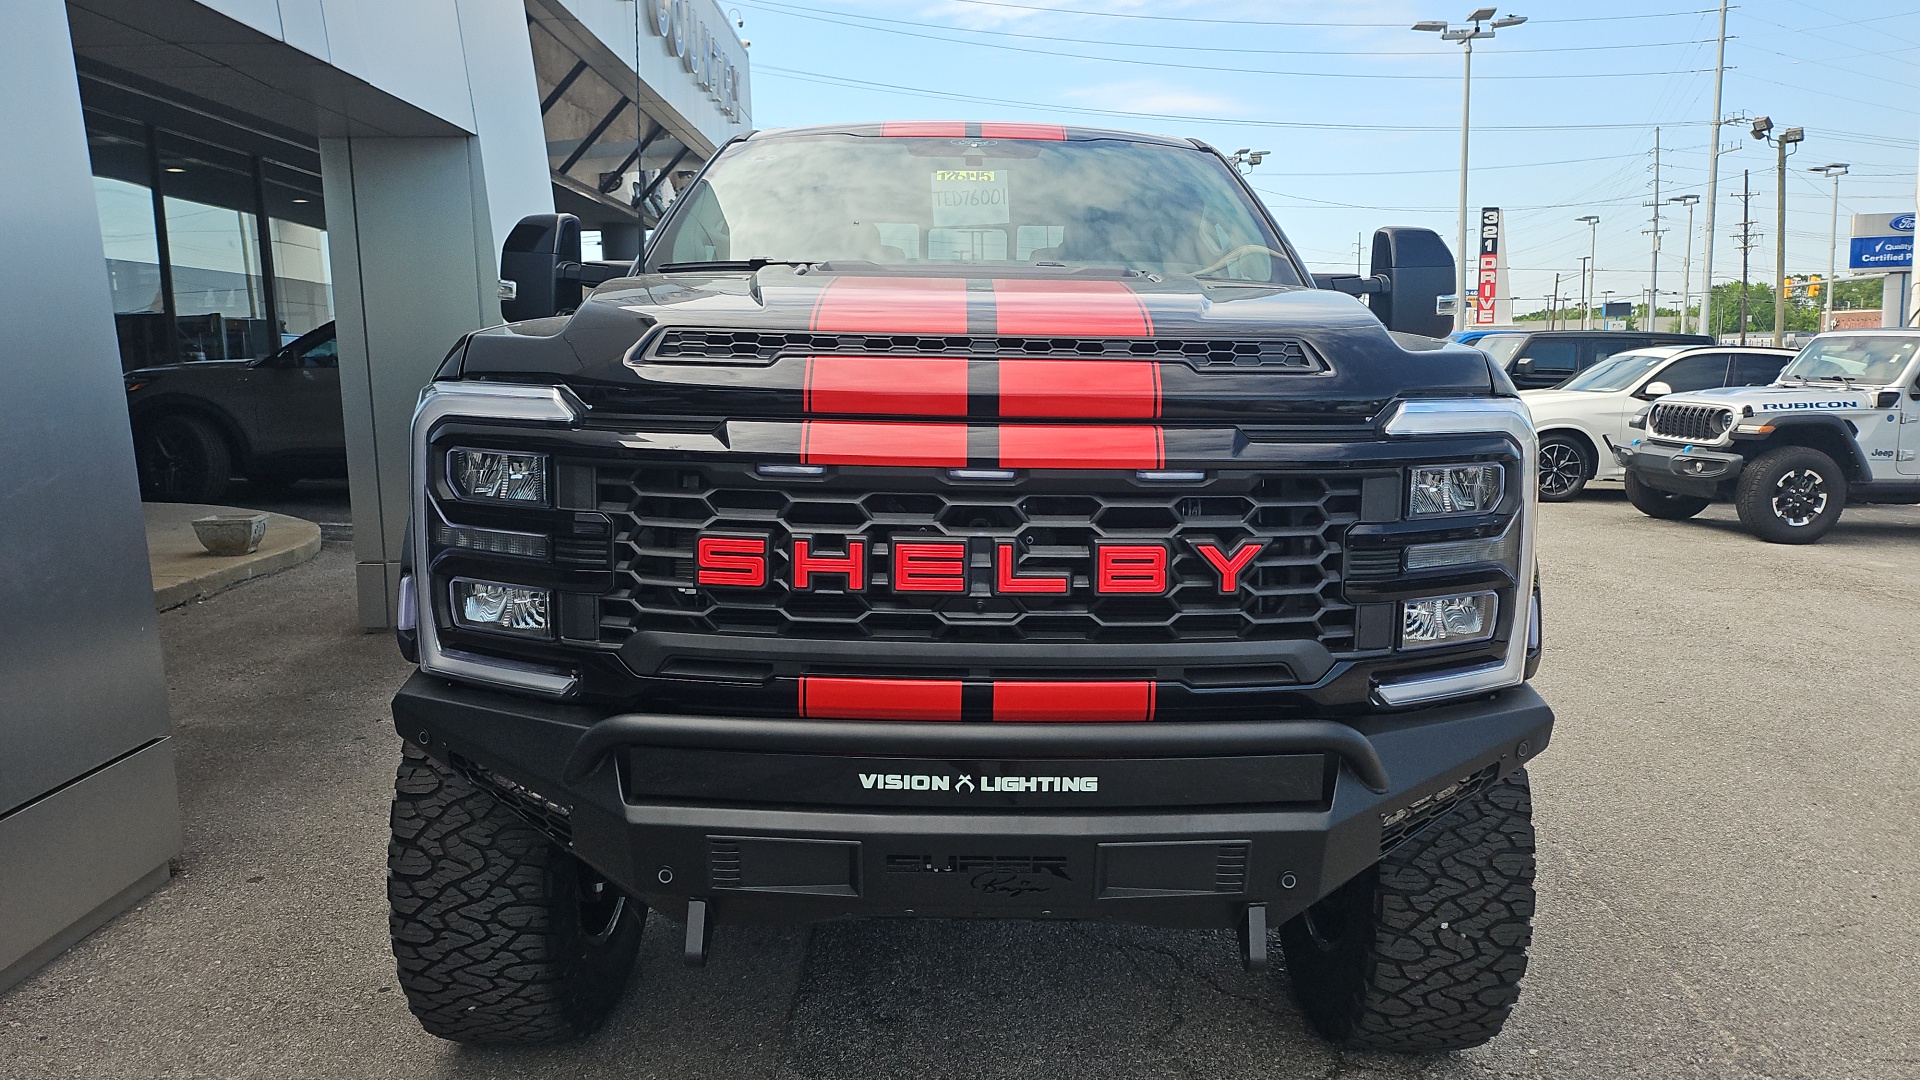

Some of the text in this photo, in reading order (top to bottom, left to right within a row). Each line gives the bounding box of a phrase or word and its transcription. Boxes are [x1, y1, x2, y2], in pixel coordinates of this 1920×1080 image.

[932, 188, 1006, 206] TED76001
[1899, 217, 1915, 229] For
[1862, 253, 1904, 262] Certified
[1762, 401, 1857, 410] RUBICON
[1871, 448, 1894, 458] Jeep
[696, 534, 1264, 595] SHELBY
[858, 773, 1098, 792] VISION LIGHTING
[886, 854, 1072, 882] SUPER
